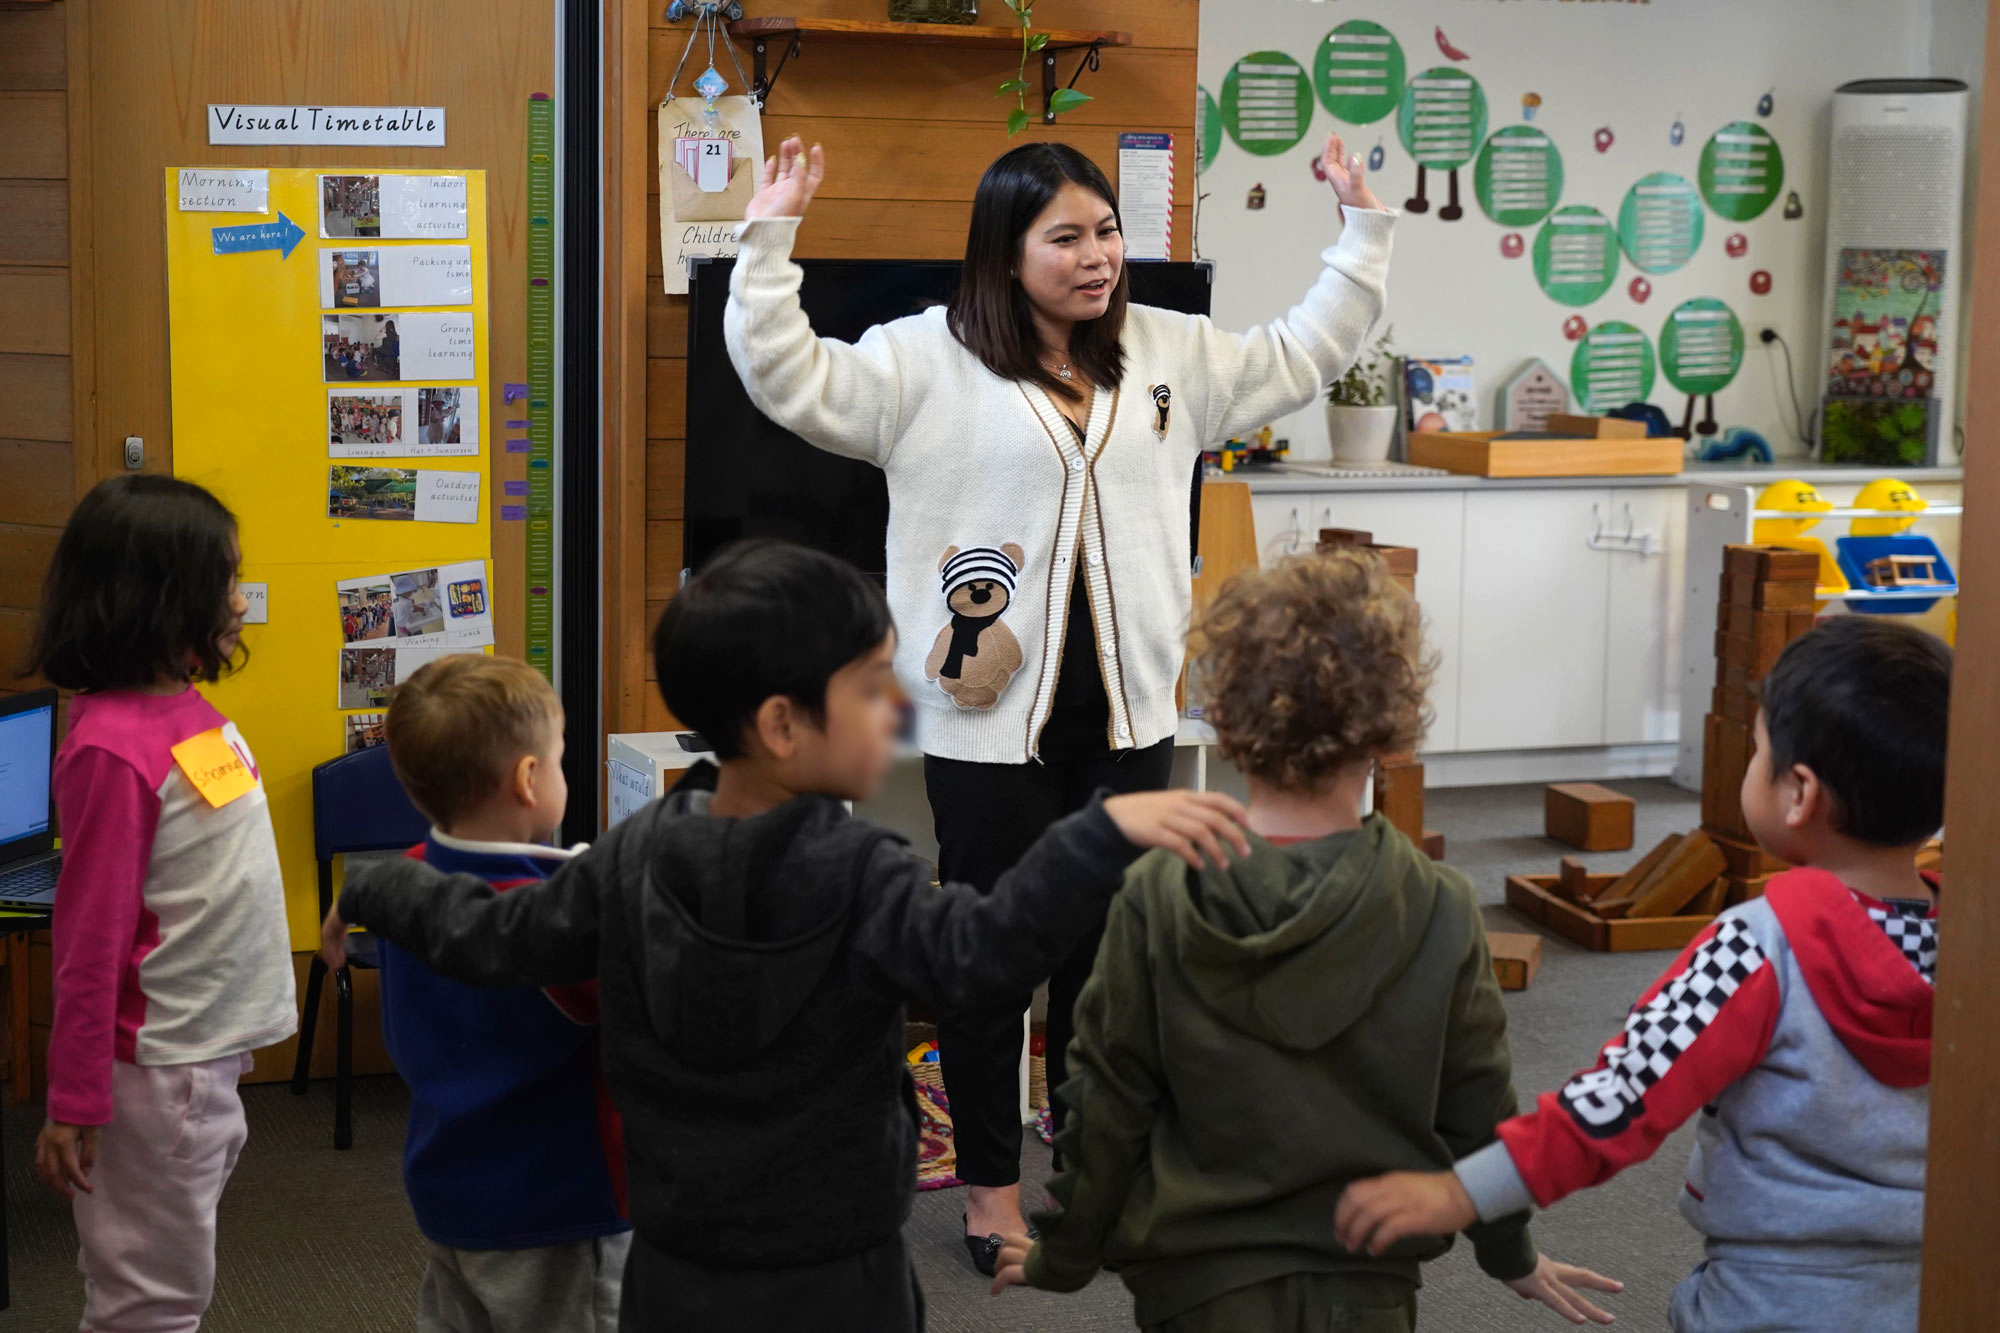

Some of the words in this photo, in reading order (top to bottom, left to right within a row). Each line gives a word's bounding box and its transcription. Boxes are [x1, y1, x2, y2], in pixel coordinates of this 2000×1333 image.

[215, 107, 299, 130] Visual
[308, 108, 436, 131] Timetable
[673, 121, 709, 139] There
[718, 129, 741, 139] are
[706, 145, 721, 155] 21
[181, 172, 254, 193] Morning
[429, 178, 465, 188] Indoor
[182, 195, 237, 206] section
[419, 198, 466, 210] learning
[416, 220, 465, 229] activities
[216, 232, 235, 242] We
[240, 233, 256, 241] are
[682, 226, 738, 244] Childre
[412, 256, 453, 269] Packing
[446, 270, 470, 278] time
[440, 322, 472, 335] Group
[449, 337, 472, 345] time
[428, 348, 473, 360] learning
[434, 446, 473, 454] Sunscreen
[436, 478, 478, 490] Outdoor
[430, 493, 478, 503] activities
